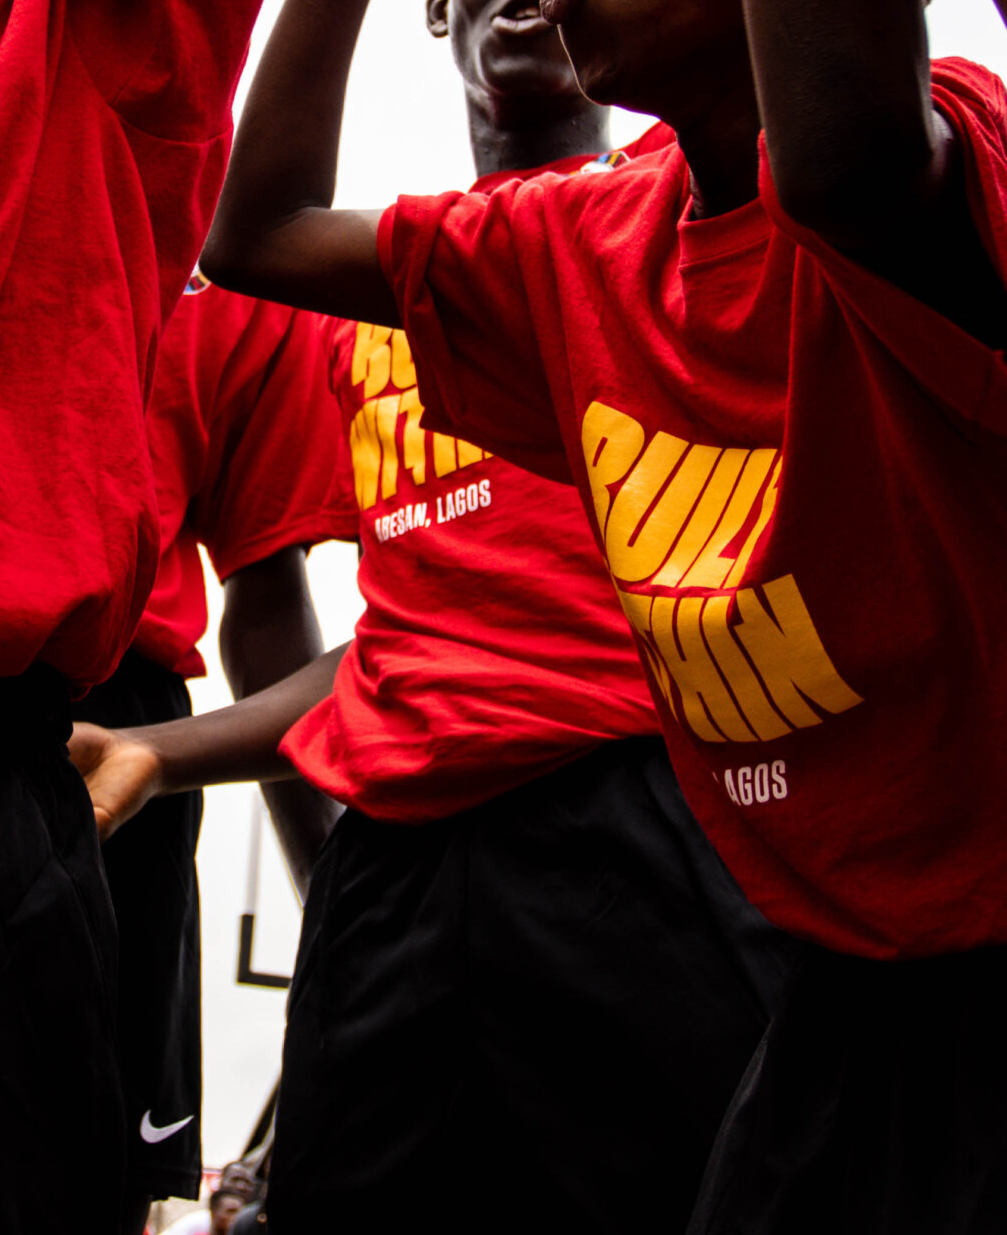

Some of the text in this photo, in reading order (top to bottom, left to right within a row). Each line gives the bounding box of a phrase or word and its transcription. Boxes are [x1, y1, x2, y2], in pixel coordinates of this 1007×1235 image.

[350, 387, 494, 511] WIT
[436, 479, 492, 524] LAGOS
[713, 759, 788, 806] AGOS
